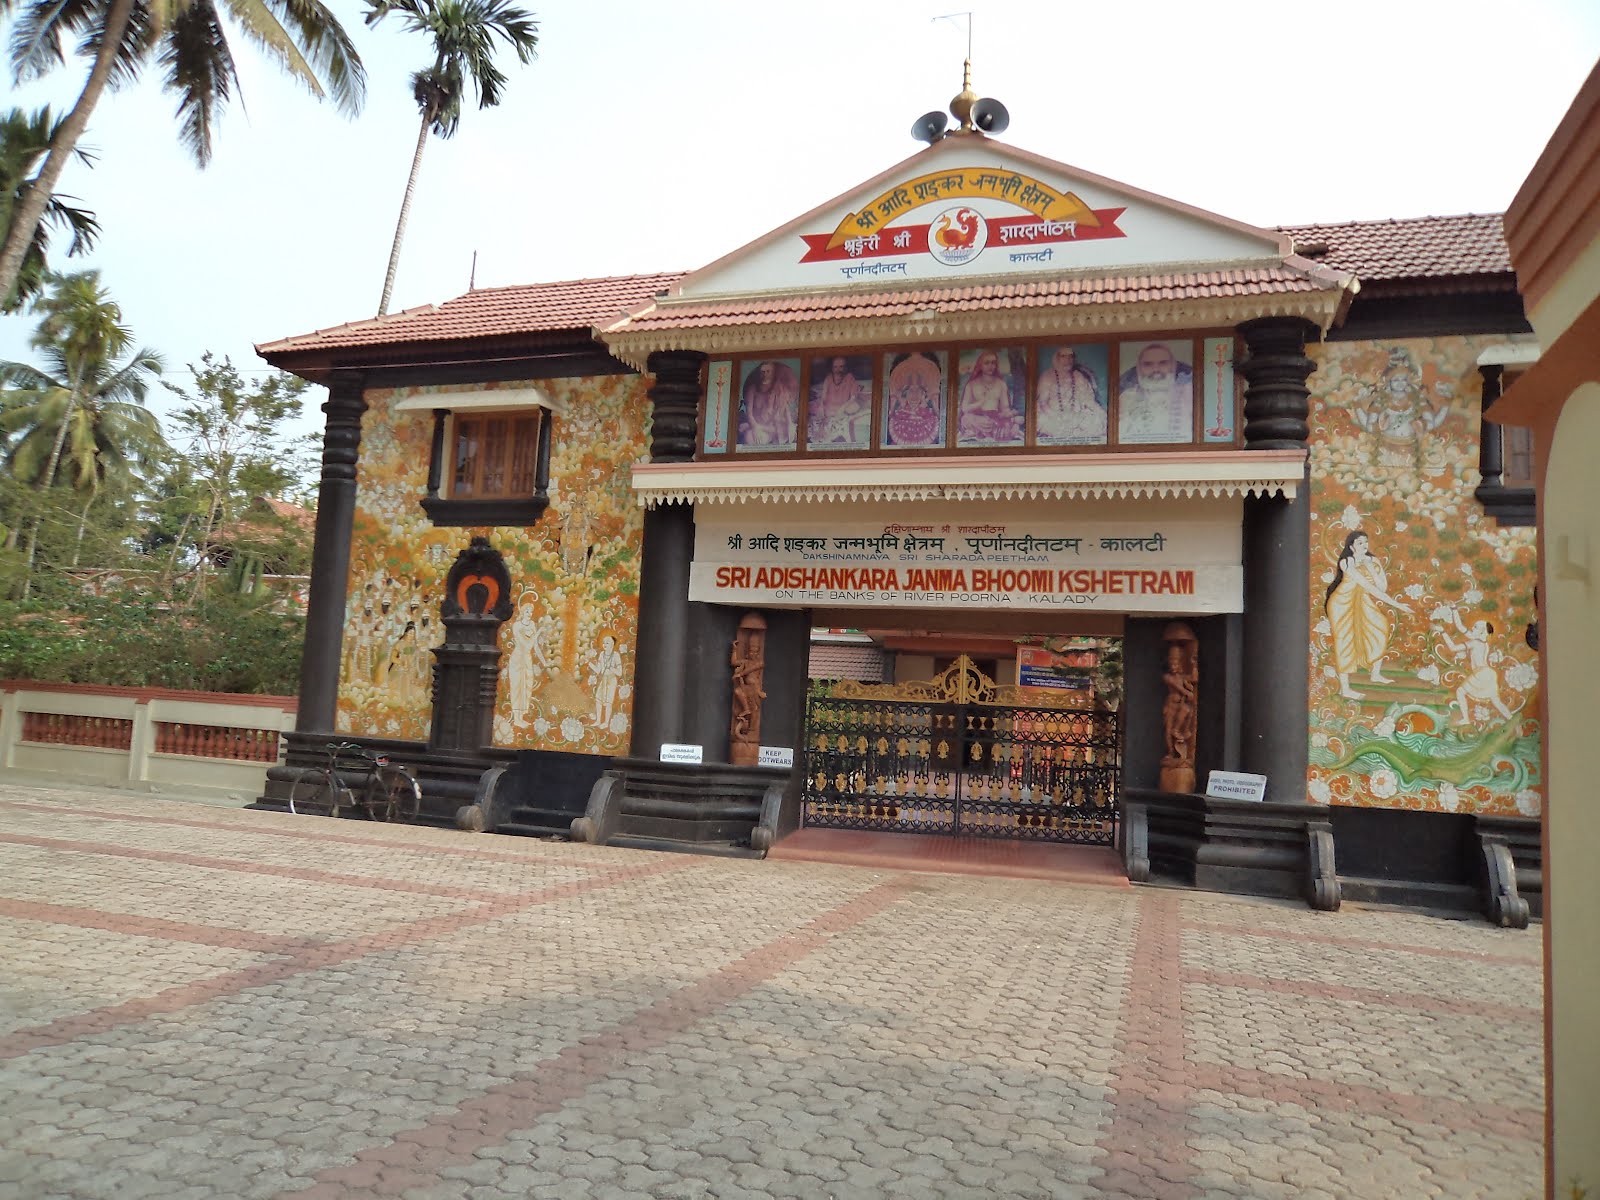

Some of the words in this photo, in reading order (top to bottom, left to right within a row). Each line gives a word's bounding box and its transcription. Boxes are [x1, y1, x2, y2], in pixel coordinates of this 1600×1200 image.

[893, 230, 912, 248] श्री
[1000, 219, 1077, 244] शारदापीठम्
[1009, 248, 1054, 263] कालटी
[839, 262, 908, 279] पूर्णानदीतटम्
[727, 534, 743, 550] श्री
[748, 534, 780, 553] आदि
[832, 534, 900, 555] जन्मभूमि
[964, 533, 1083, 556] पूर्णानदीतटम्
[1100, 532, 1167, 552] कालटी
[802, 553, 890, 561] DAKSHINAMNAYA
[986, 555, 1049, 563] PEETHAM
[715, 566, 751, 589] SRI
[753, 567, 899, 592] ADISHANKARA
[902, 569, 968, 592] JANMA
[971, 569, 1053, 593] BHOOMI
[1058, 570, 1194, 595] KSHETRAM
[775, 590, 794, 599] ON
[799, 590, 823, 599] THE
[830, 591, 875, 600] BANKS
[880, 592, 897, 600] OF
[904, 592, 945, 601] RIVER
[950, 593, 1012, 602] POORNA
[1029, 595, 1099, 604] KALADY
[765, 749, 782, 757] KEEP
[758, 756, 792, 765] OOTWEARS
[1213, 785, 1256, 795] PROHIBITED
